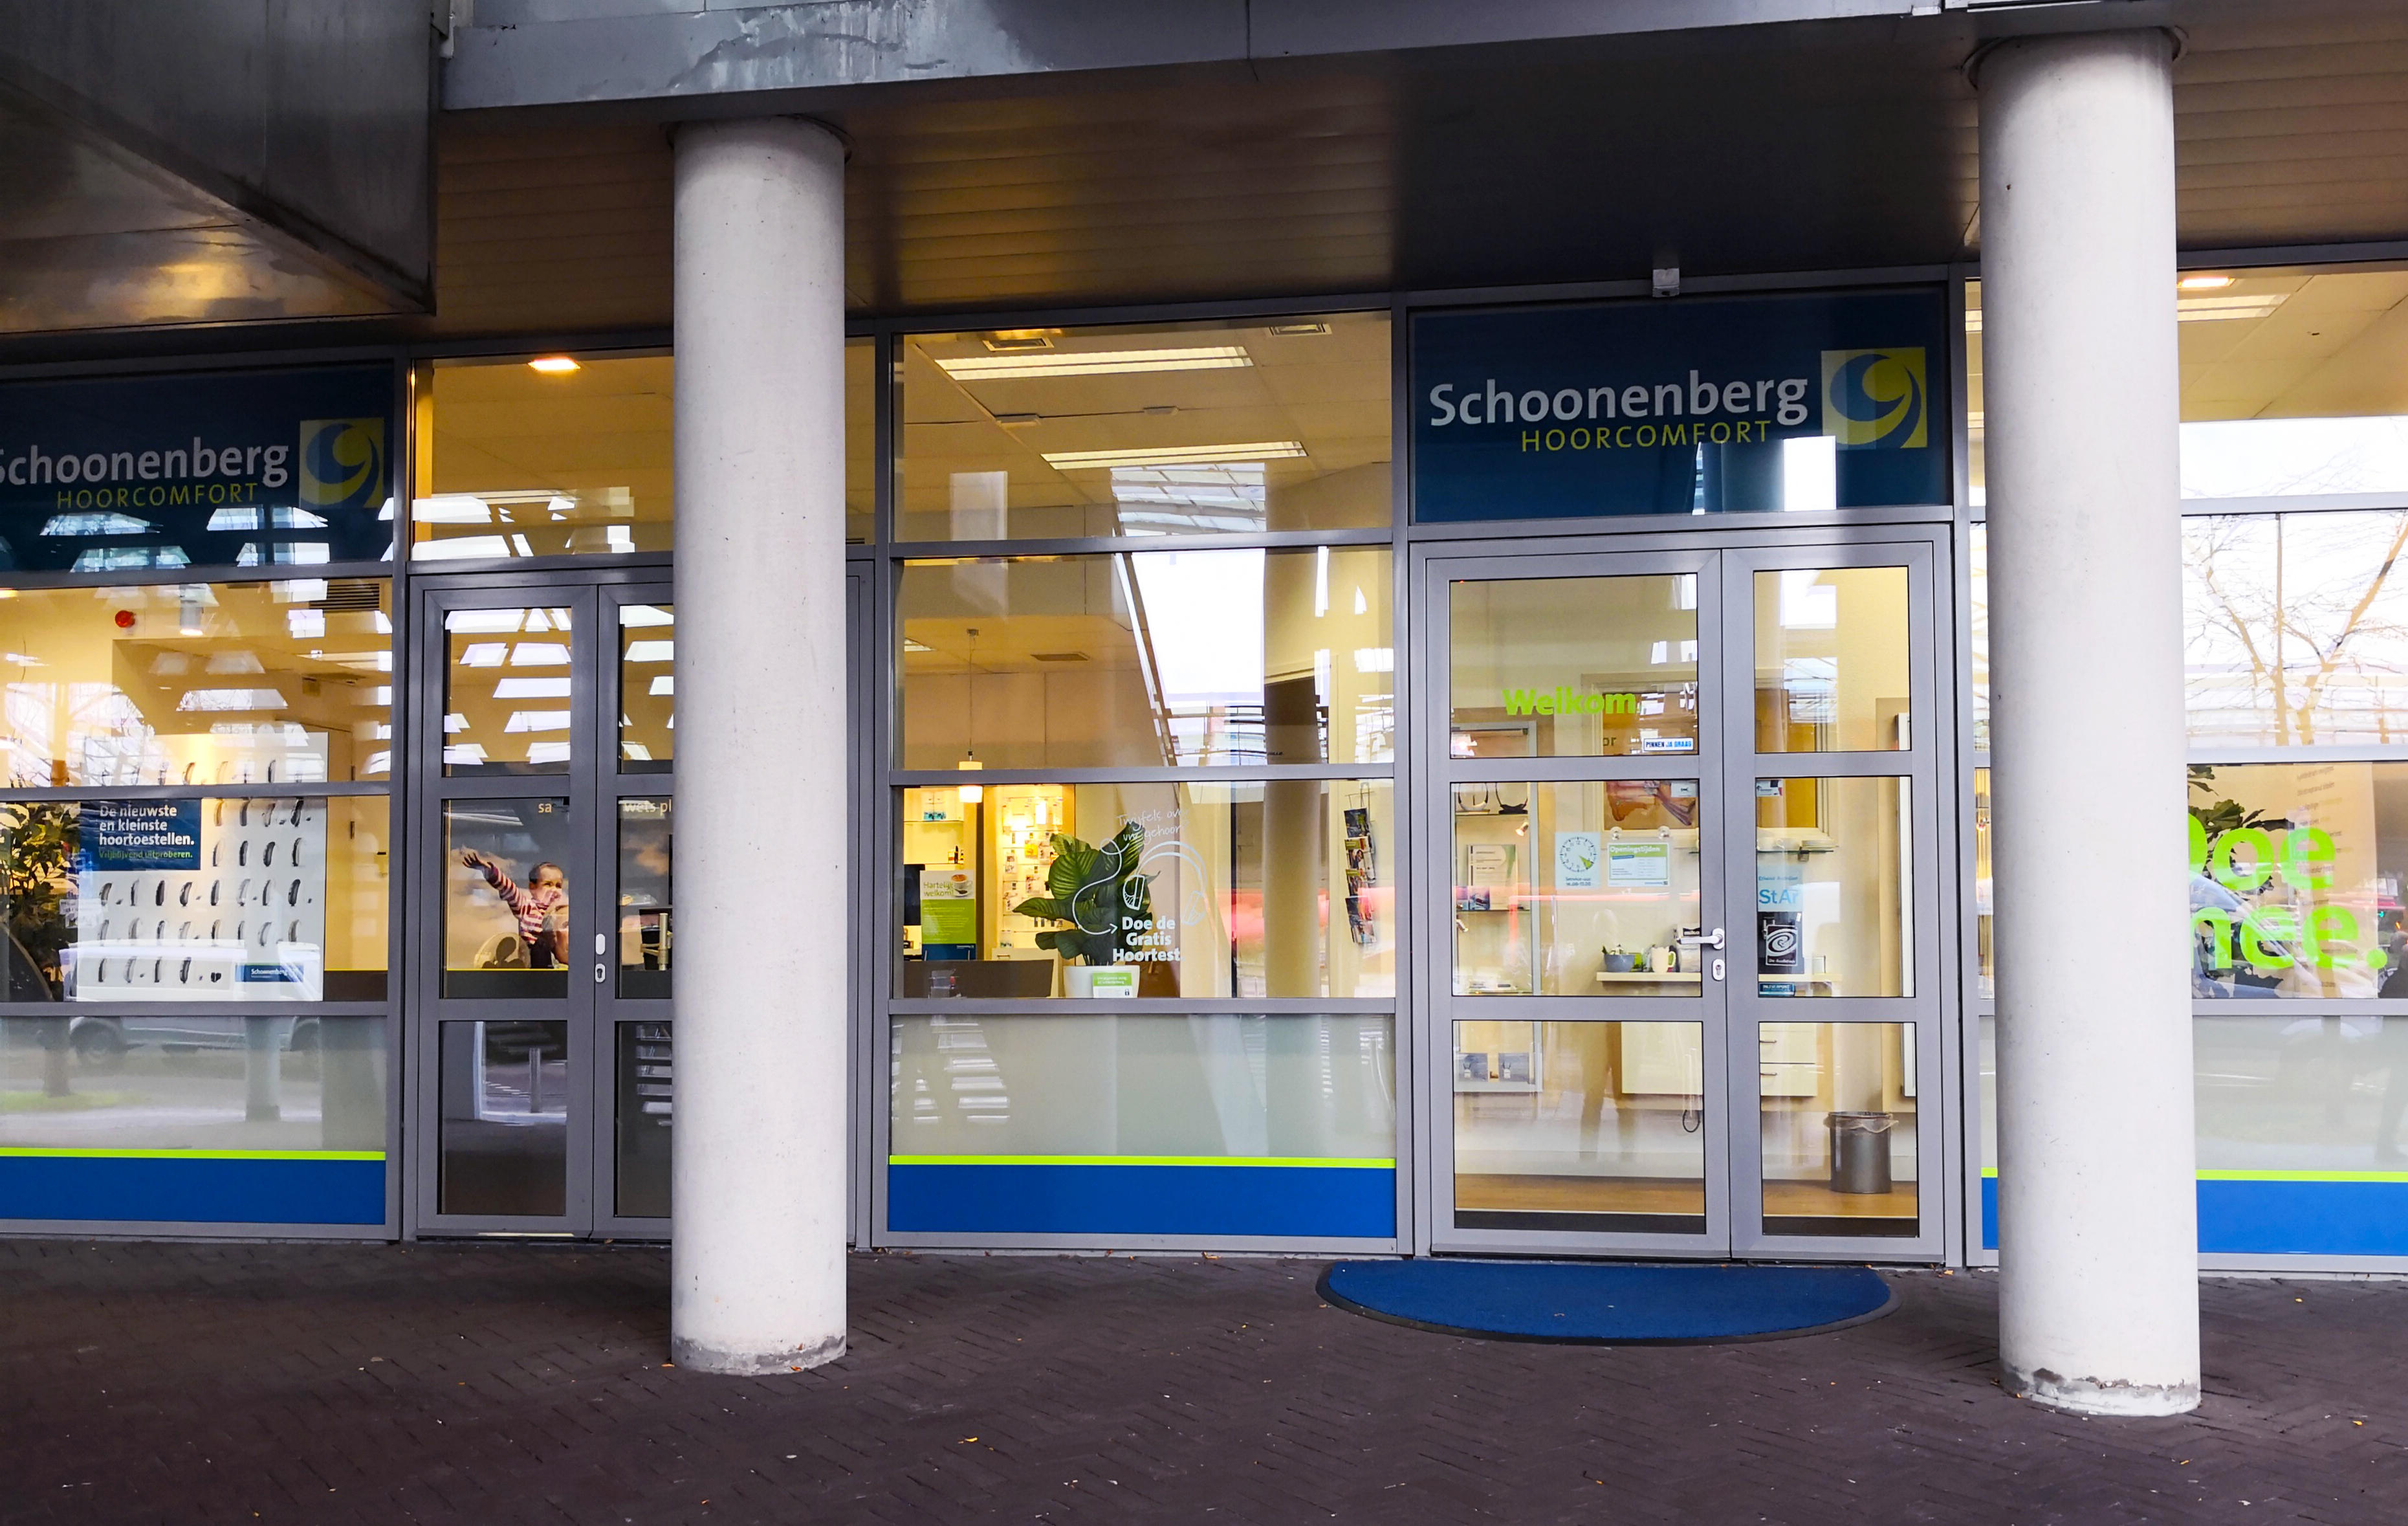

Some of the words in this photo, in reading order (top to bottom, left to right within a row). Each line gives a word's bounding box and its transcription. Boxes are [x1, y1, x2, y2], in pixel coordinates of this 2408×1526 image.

[1429, 370, 1809, 427] Schoonenberg
[1522, 419, 1772, 452] HOORCOMFORT
[57, 483, 257, 509] HOORCOMFORT
[1502, 686, 1637, 716] Welkom
[99, 806, 116, 817] De
[120, 804, 177, 817] nieuwste
[99, 821, 115, 831] en
[118, 819, 168, 831] kleinste
[99, 832, 195, 845] hoortoestellen.
[2189, 813, 2336, 890] oe
[1122, 916, 1152, 930] Doe
[1156, 916, 1176, 930] de
[1126, 931, 1172, 945] Gratis
